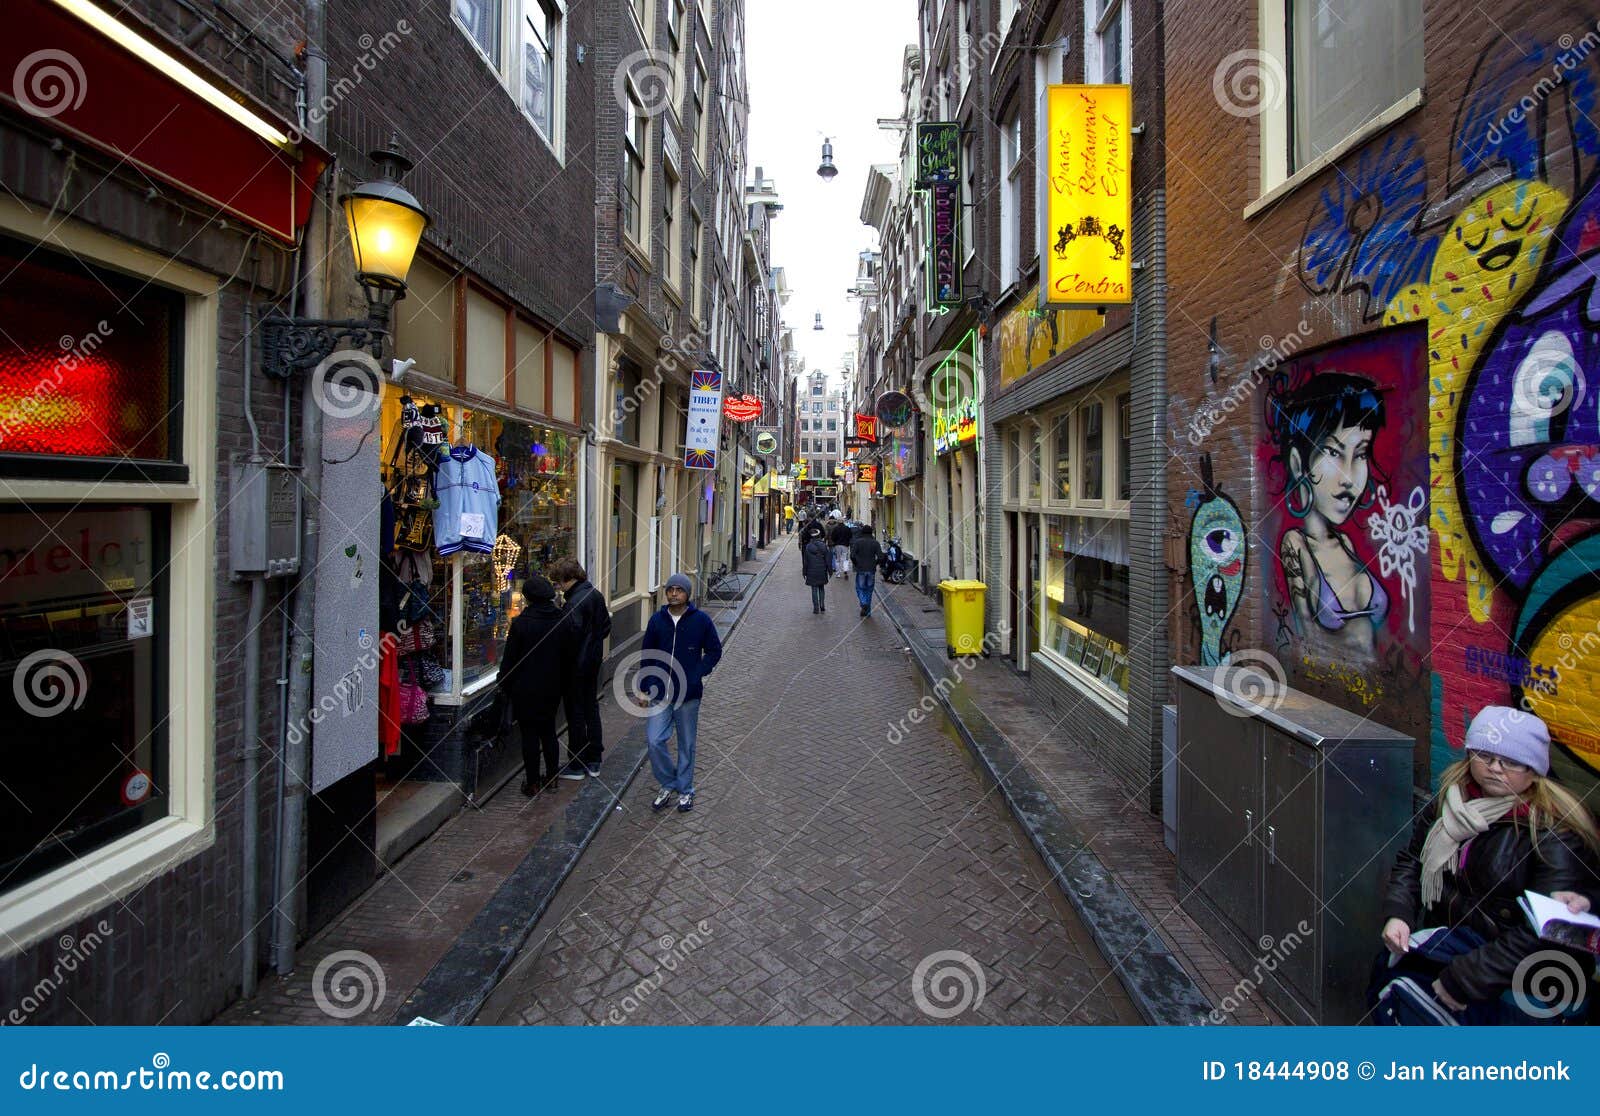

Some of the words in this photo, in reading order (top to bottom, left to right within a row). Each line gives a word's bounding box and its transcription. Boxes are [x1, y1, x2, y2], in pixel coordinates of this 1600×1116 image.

[918, 128, 959, 152] Coffee
[1078, 93, 1098, 196] Restaurant
[1052, 130, 1075, 196] Spaans
[1055, 273, 1126, 295] Centra
[693, 396, 718, 405] TIBET
[859, 421, 873, 436] 21
[1465, 644, 1532, 676] GIVING
[1465, 660, 1478, 674] IS
